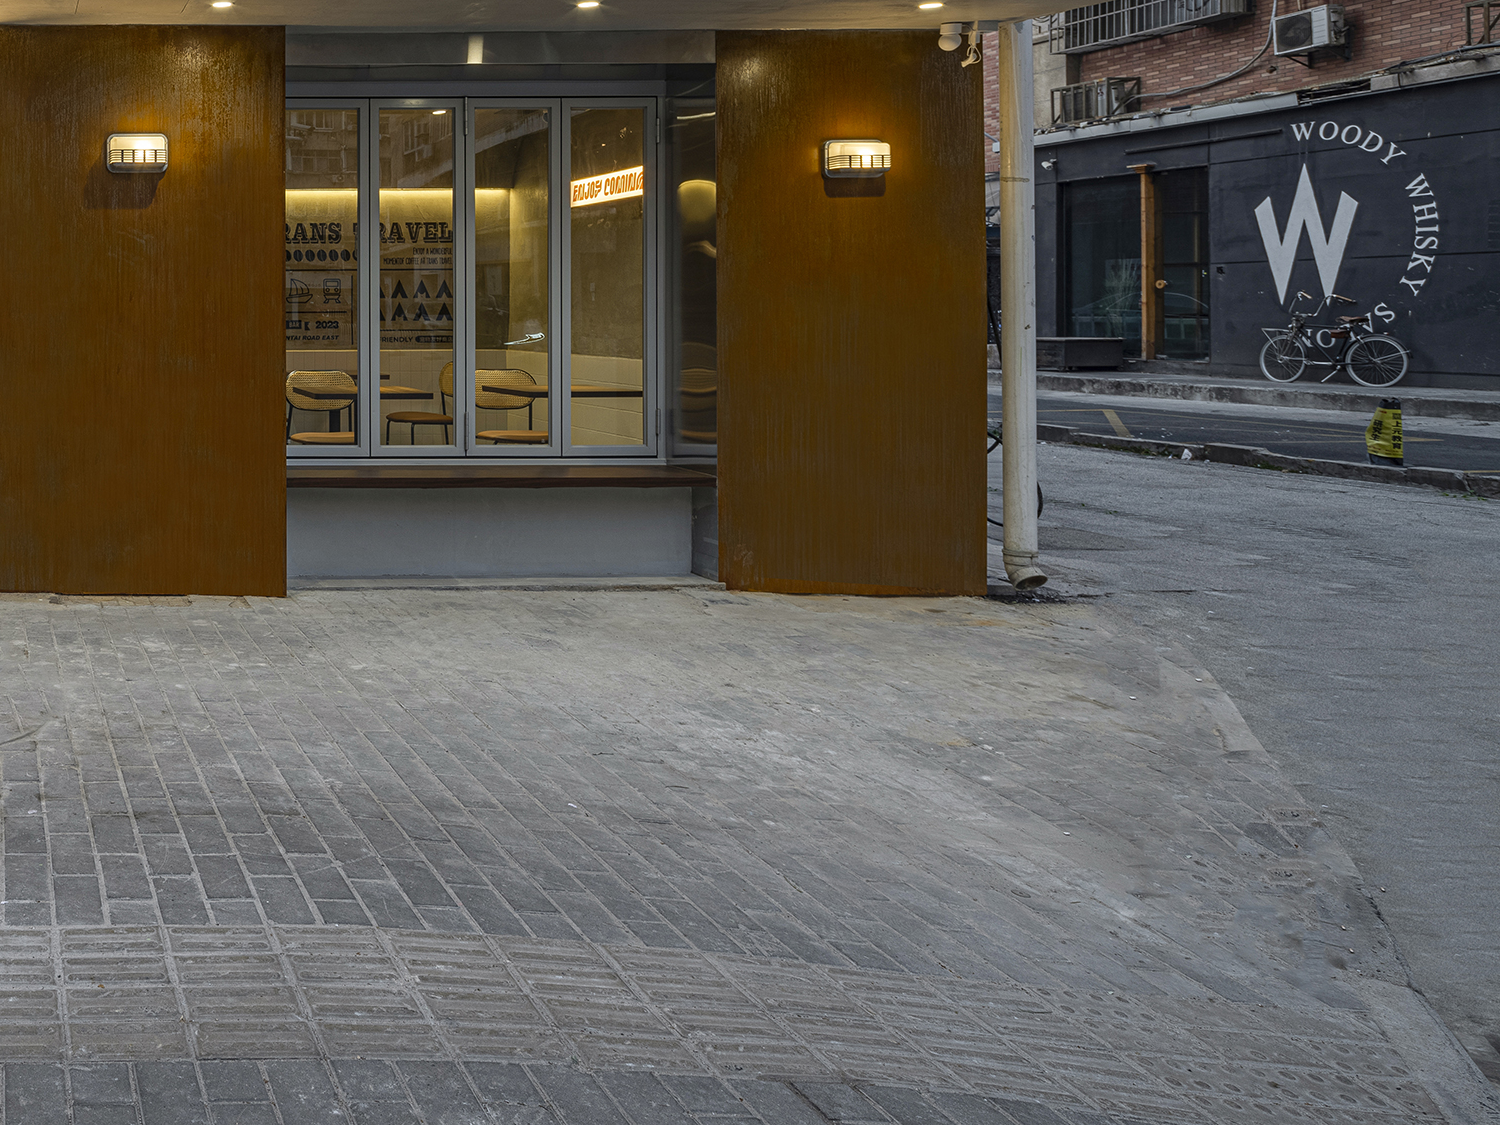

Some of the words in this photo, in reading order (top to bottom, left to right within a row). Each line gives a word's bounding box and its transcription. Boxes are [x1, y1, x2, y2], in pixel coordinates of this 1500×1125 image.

[572, 179, 603, 203] ENJOY
[1290, 120, 1407, 165] WOODY
[1399, 172, 1440, 297] WHISKY
[1254, 163, 1359, 306] W
[315, 320, 339, 329] 2023
